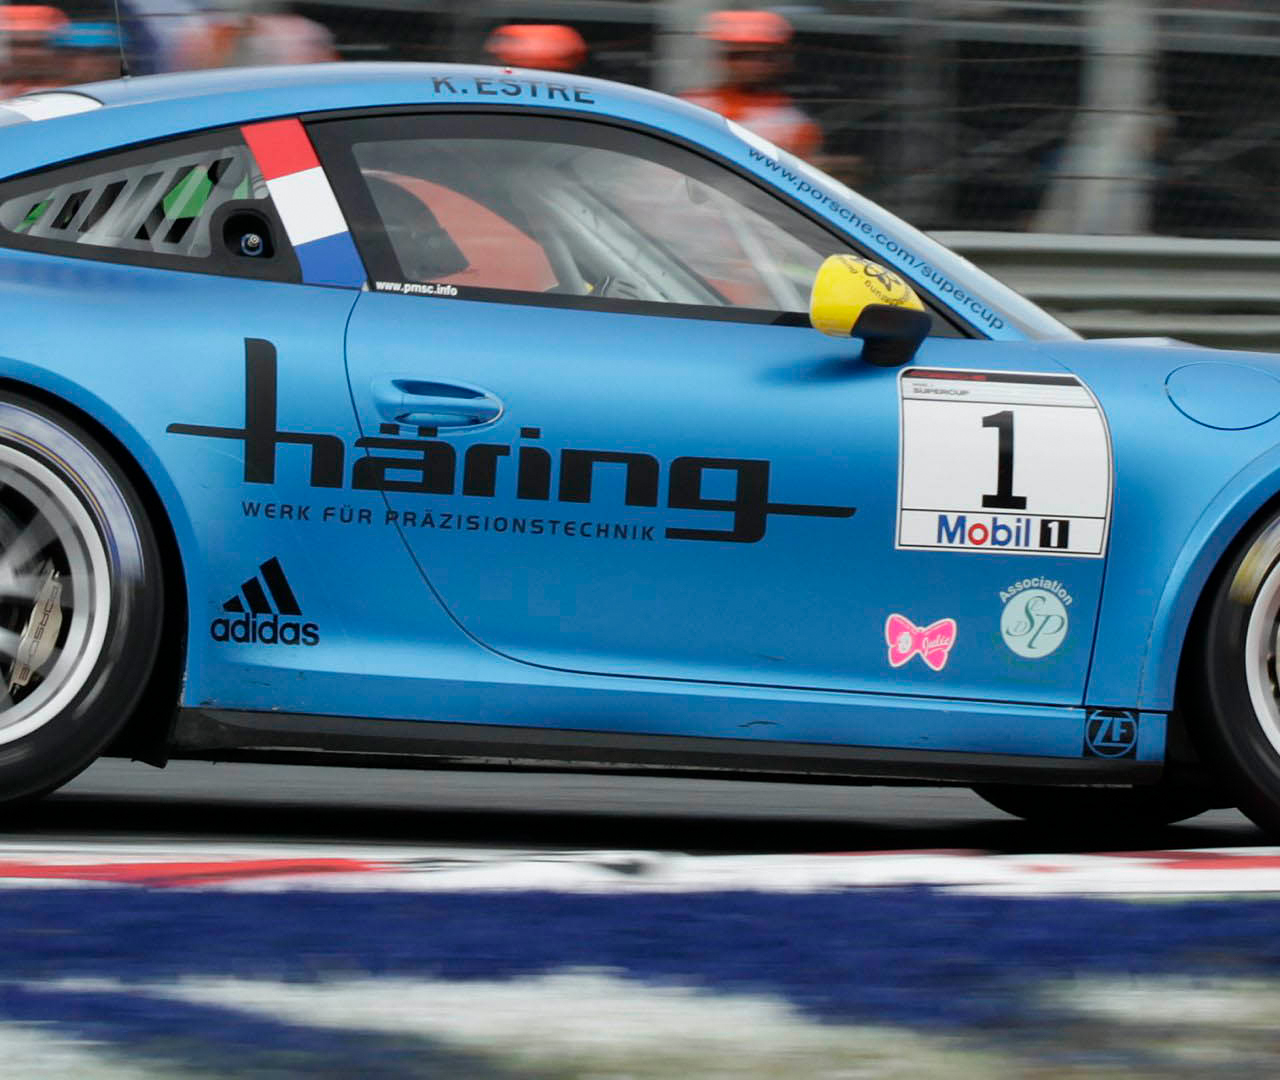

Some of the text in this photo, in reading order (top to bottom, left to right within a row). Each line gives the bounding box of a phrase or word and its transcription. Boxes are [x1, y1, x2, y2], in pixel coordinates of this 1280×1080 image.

[748, 148, 1004, 332] www.porsche.com/supercup
[376, 281, 458, 296] www.pmsc.info
[166, 336, 858, 544] häring
[981, 410, 1027, 510] 1
[241, 501, 656, 542] WERK FÜR PRÄZISIONSTECHNIK
[936, 515, 1030, 548] Mobil
[999, 576, 1073, 606] Association
[209, 611, 321, 647] adidas
